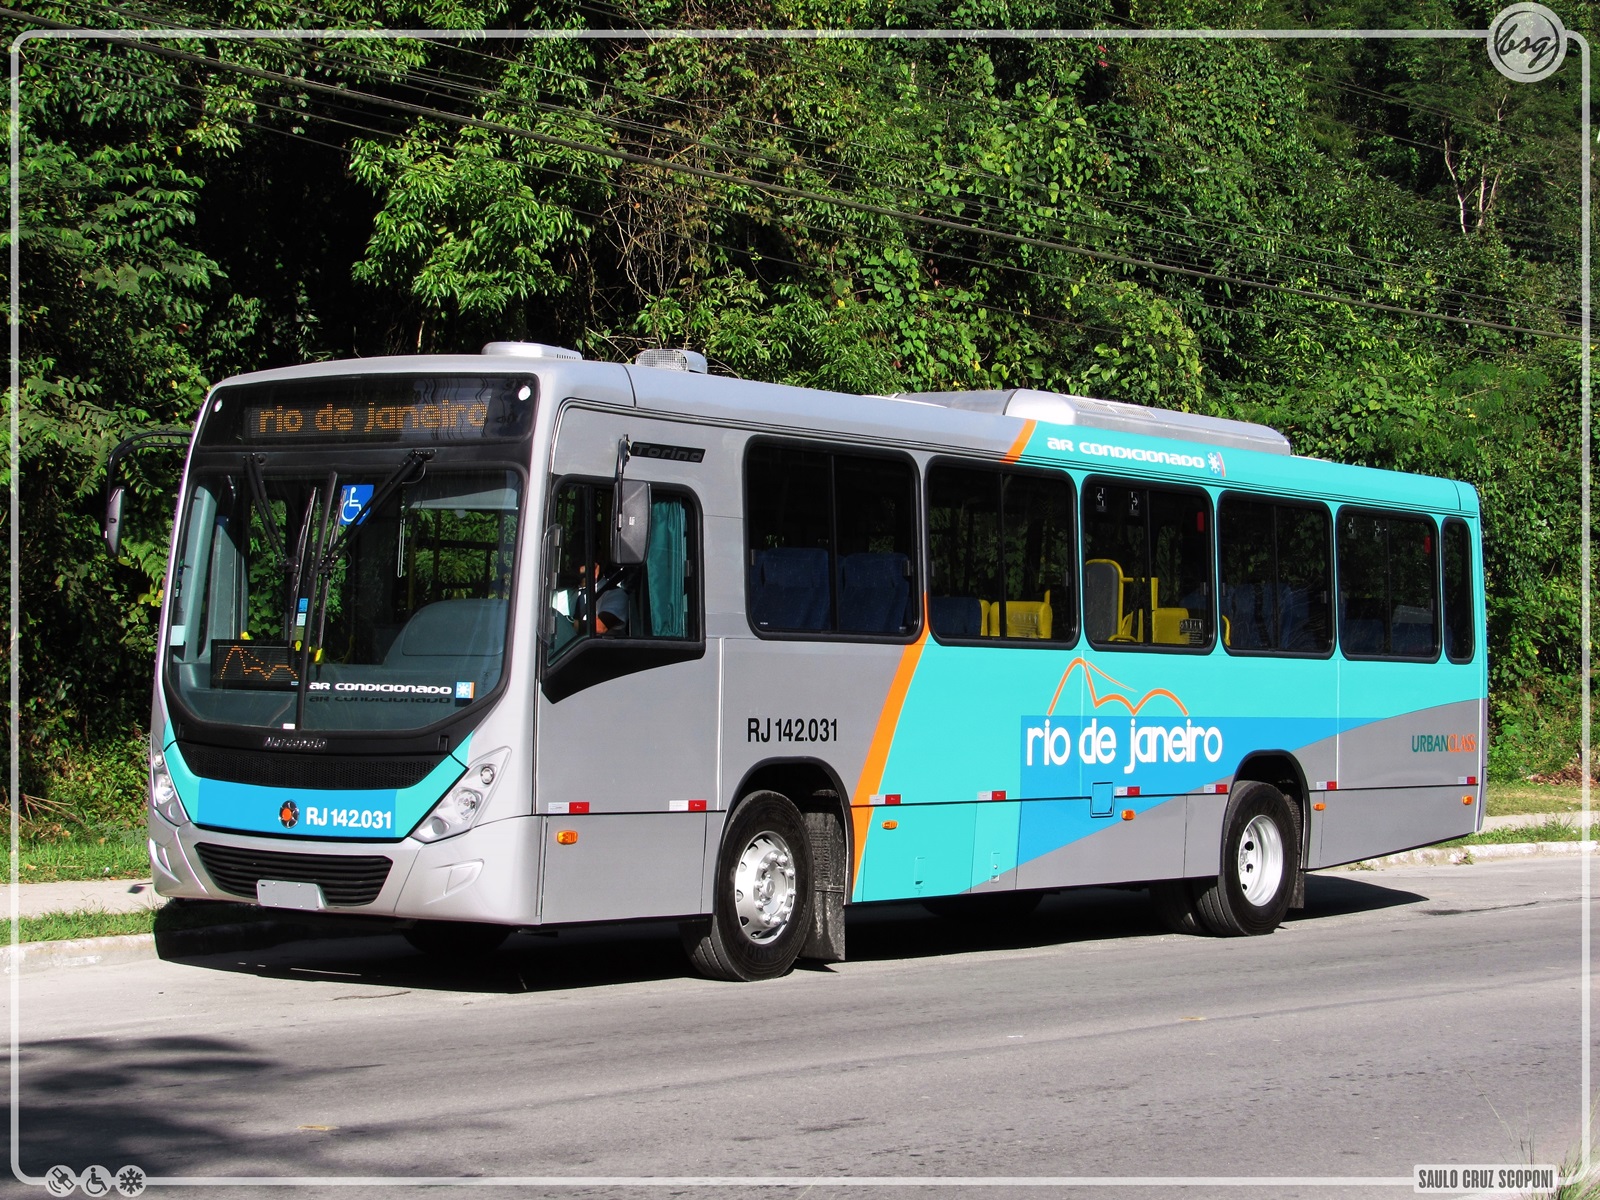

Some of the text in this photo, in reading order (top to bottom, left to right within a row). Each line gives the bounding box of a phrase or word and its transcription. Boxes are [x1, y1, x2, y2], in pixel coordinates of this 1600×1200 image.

[259, 400, 488, 432] rio de janeiro
[633, 444, 703, 462] Torino
[747, 717, 837, 742] RJ 142.031
[1026, 718, 1223, 775] rio de janeiro
[306, 806, 392, 829] RJ 142.031
